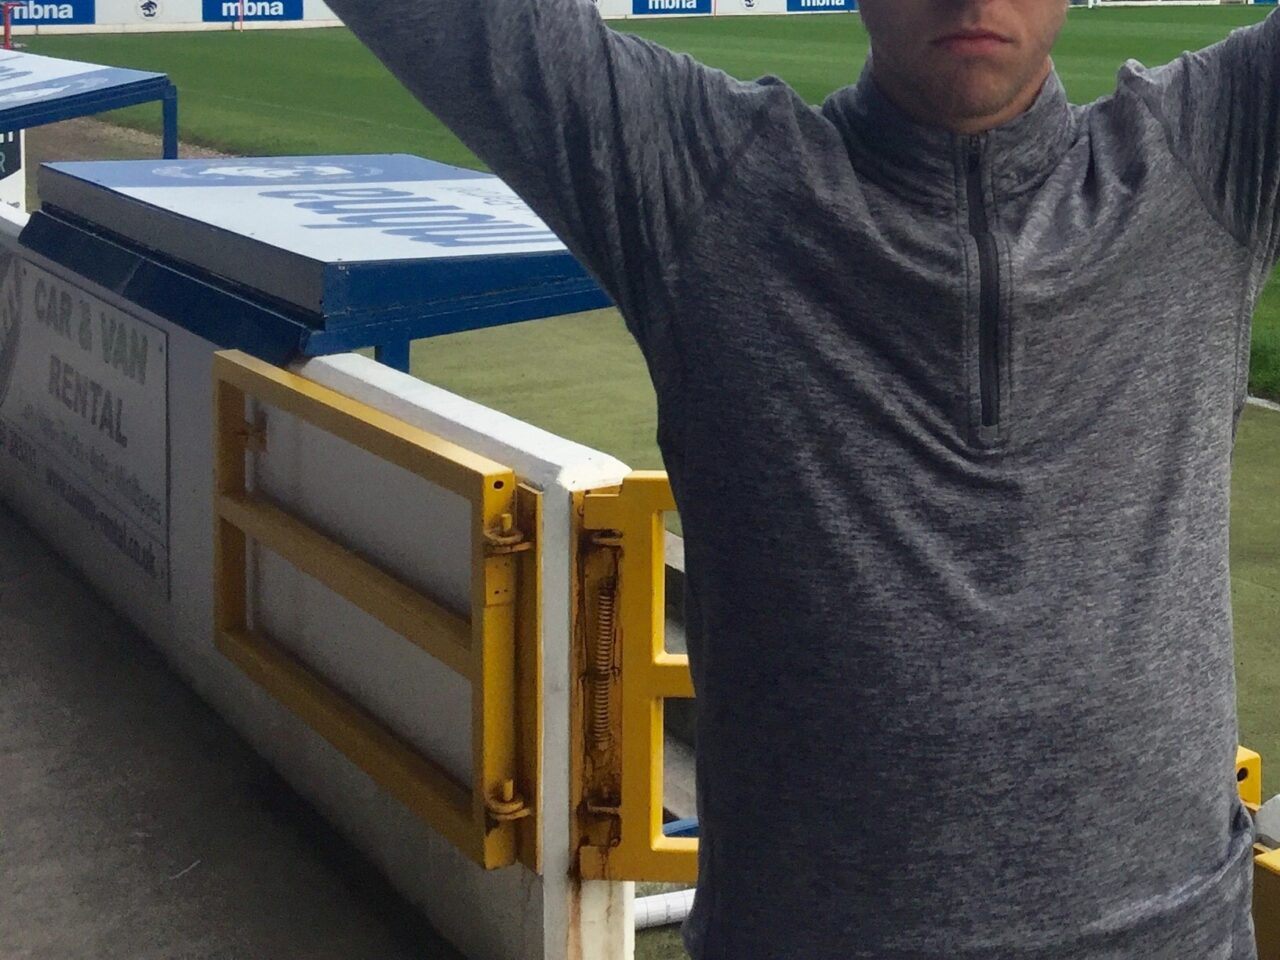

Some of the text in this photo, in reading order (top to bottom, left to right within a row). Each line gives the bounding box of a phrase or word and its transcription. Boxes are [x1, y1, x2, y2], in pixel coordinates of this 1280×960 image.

[35, 278, 73, 340] CAR
[79, 299, 93, 352] &
[100, 311, 149, 386] VAN
[50, 354, 128, 449] RENTAL
